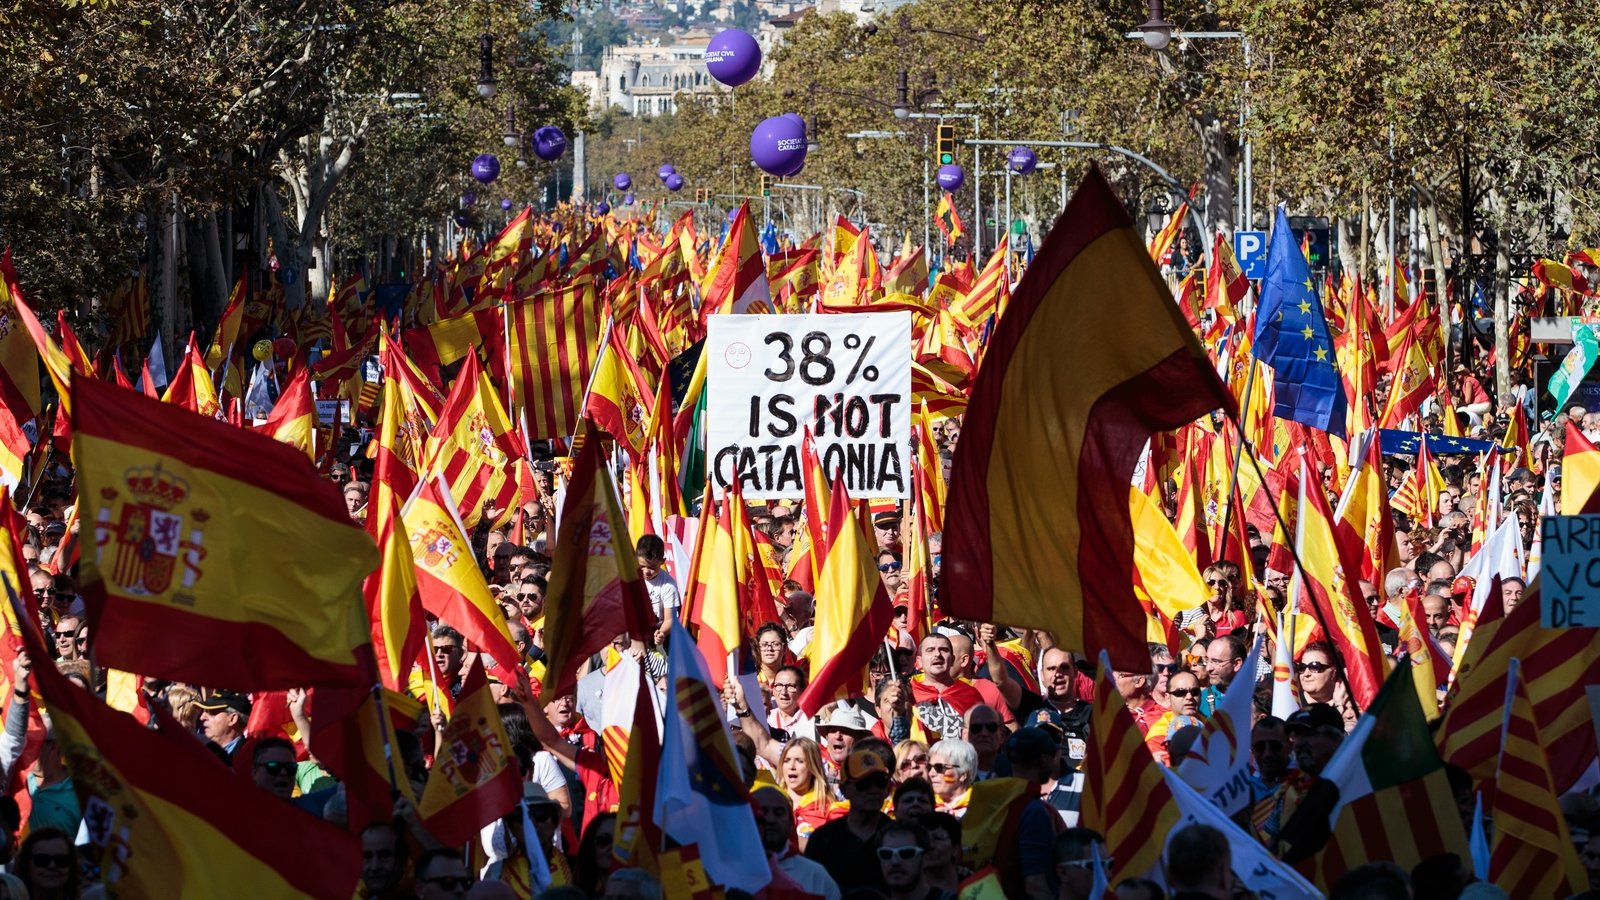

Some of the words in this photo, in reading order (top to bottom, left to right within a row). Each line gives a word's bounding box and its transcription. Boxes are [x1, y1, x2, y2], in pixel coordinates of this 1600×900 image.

[777, 138, 802, 146] SOCIETAT
[1240, 235, 1260, 260] P
[764, 331, 879, 386] 38%
[750, 393, 798, 438] IS
[813, 392, 901, 438] NOT
[713, 442, 905, 493] CATAONIA
[1552, 596, 1584, 628] DE
